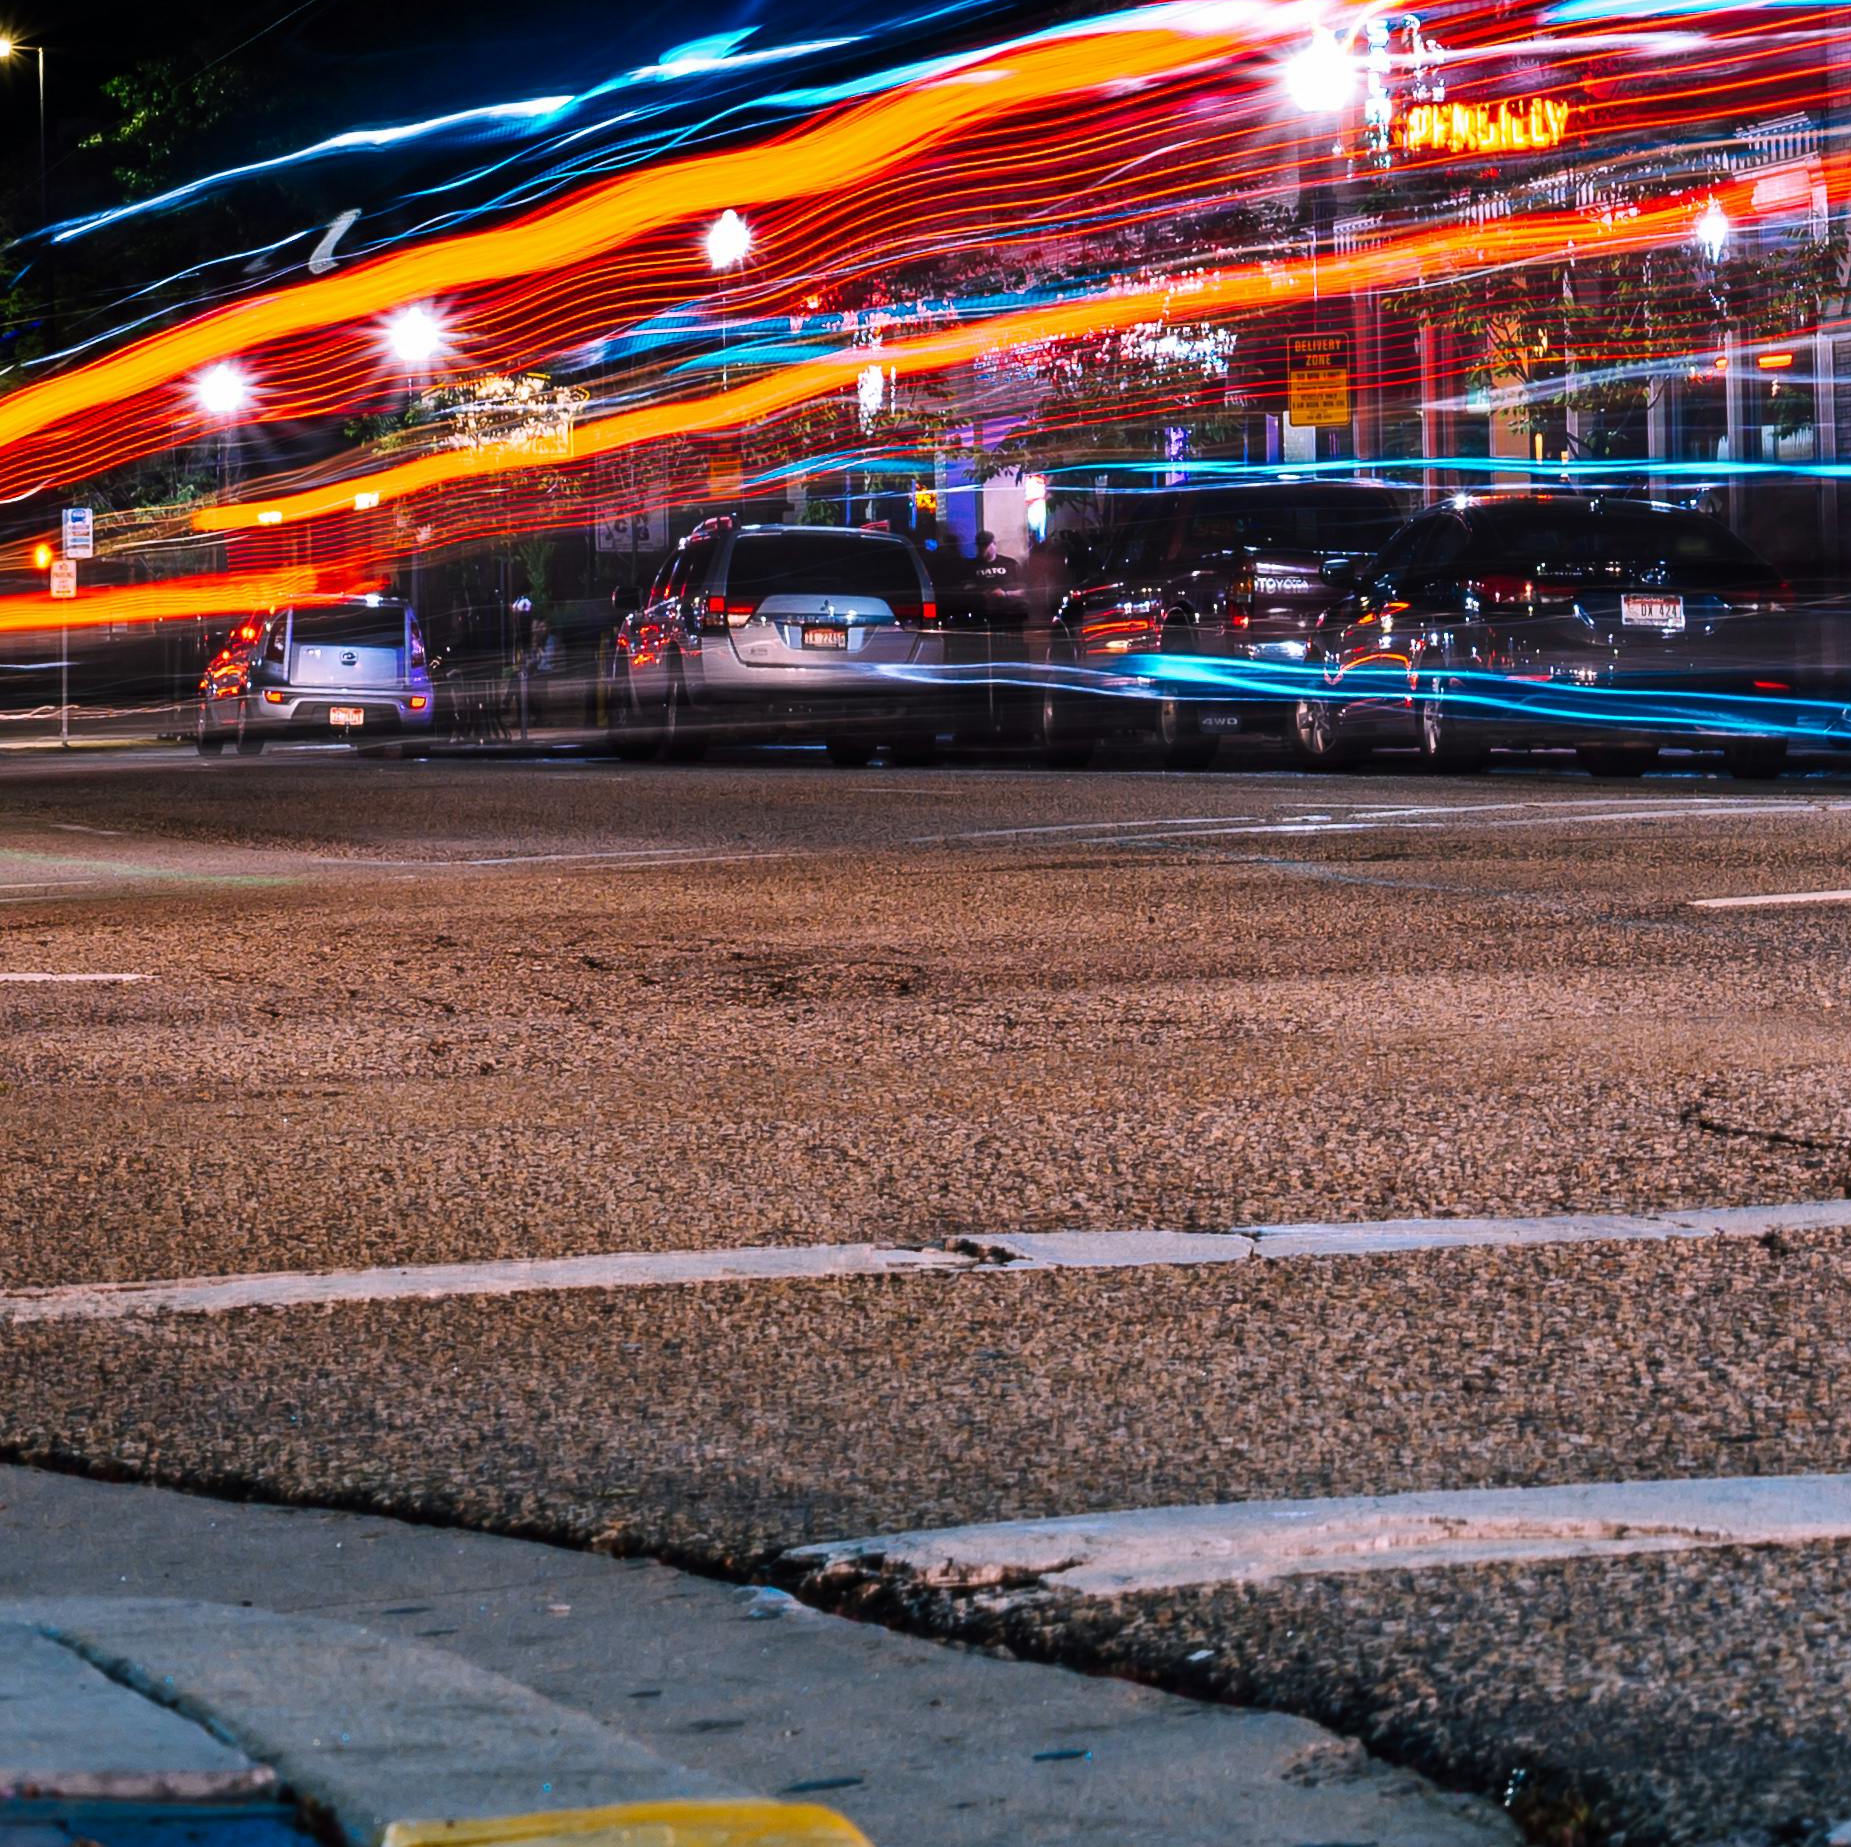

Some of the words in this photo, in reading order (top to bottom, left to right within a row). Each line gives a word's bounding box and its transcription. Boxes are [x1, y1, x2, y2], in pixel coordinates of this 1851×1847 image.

[1294, 339, 1342, 353] DELIVERY
[1305, 354, 1332, 367] ZONE
[1202, 716, 1239, 726] 4WD
